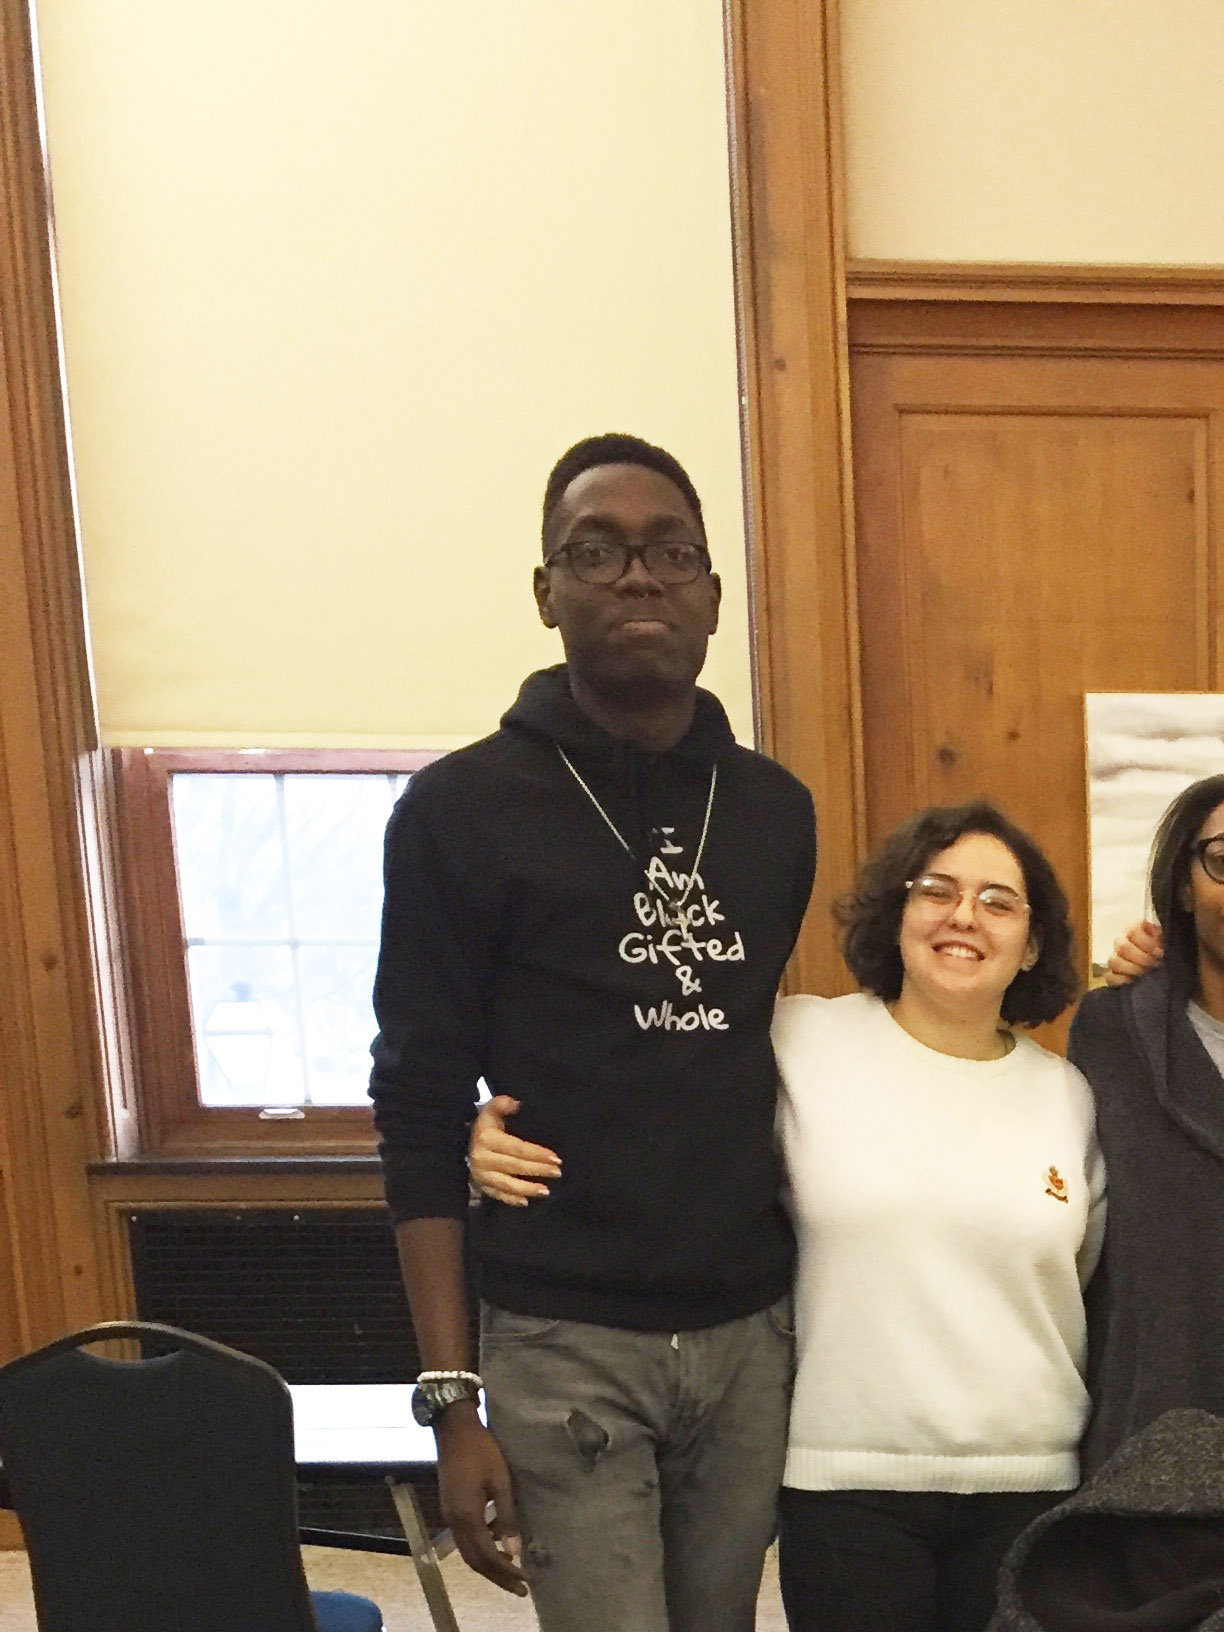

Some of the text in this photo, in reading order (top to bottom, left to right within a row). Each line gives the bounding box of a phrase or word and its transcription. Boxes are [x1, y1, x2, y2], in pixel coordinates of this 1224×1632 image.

[648, 857, 704, 891] Am
[618, 929, 745, 965] Gifted
[675, 965, 702, 996] &
[634, 1000, 730, 1031] Whole
